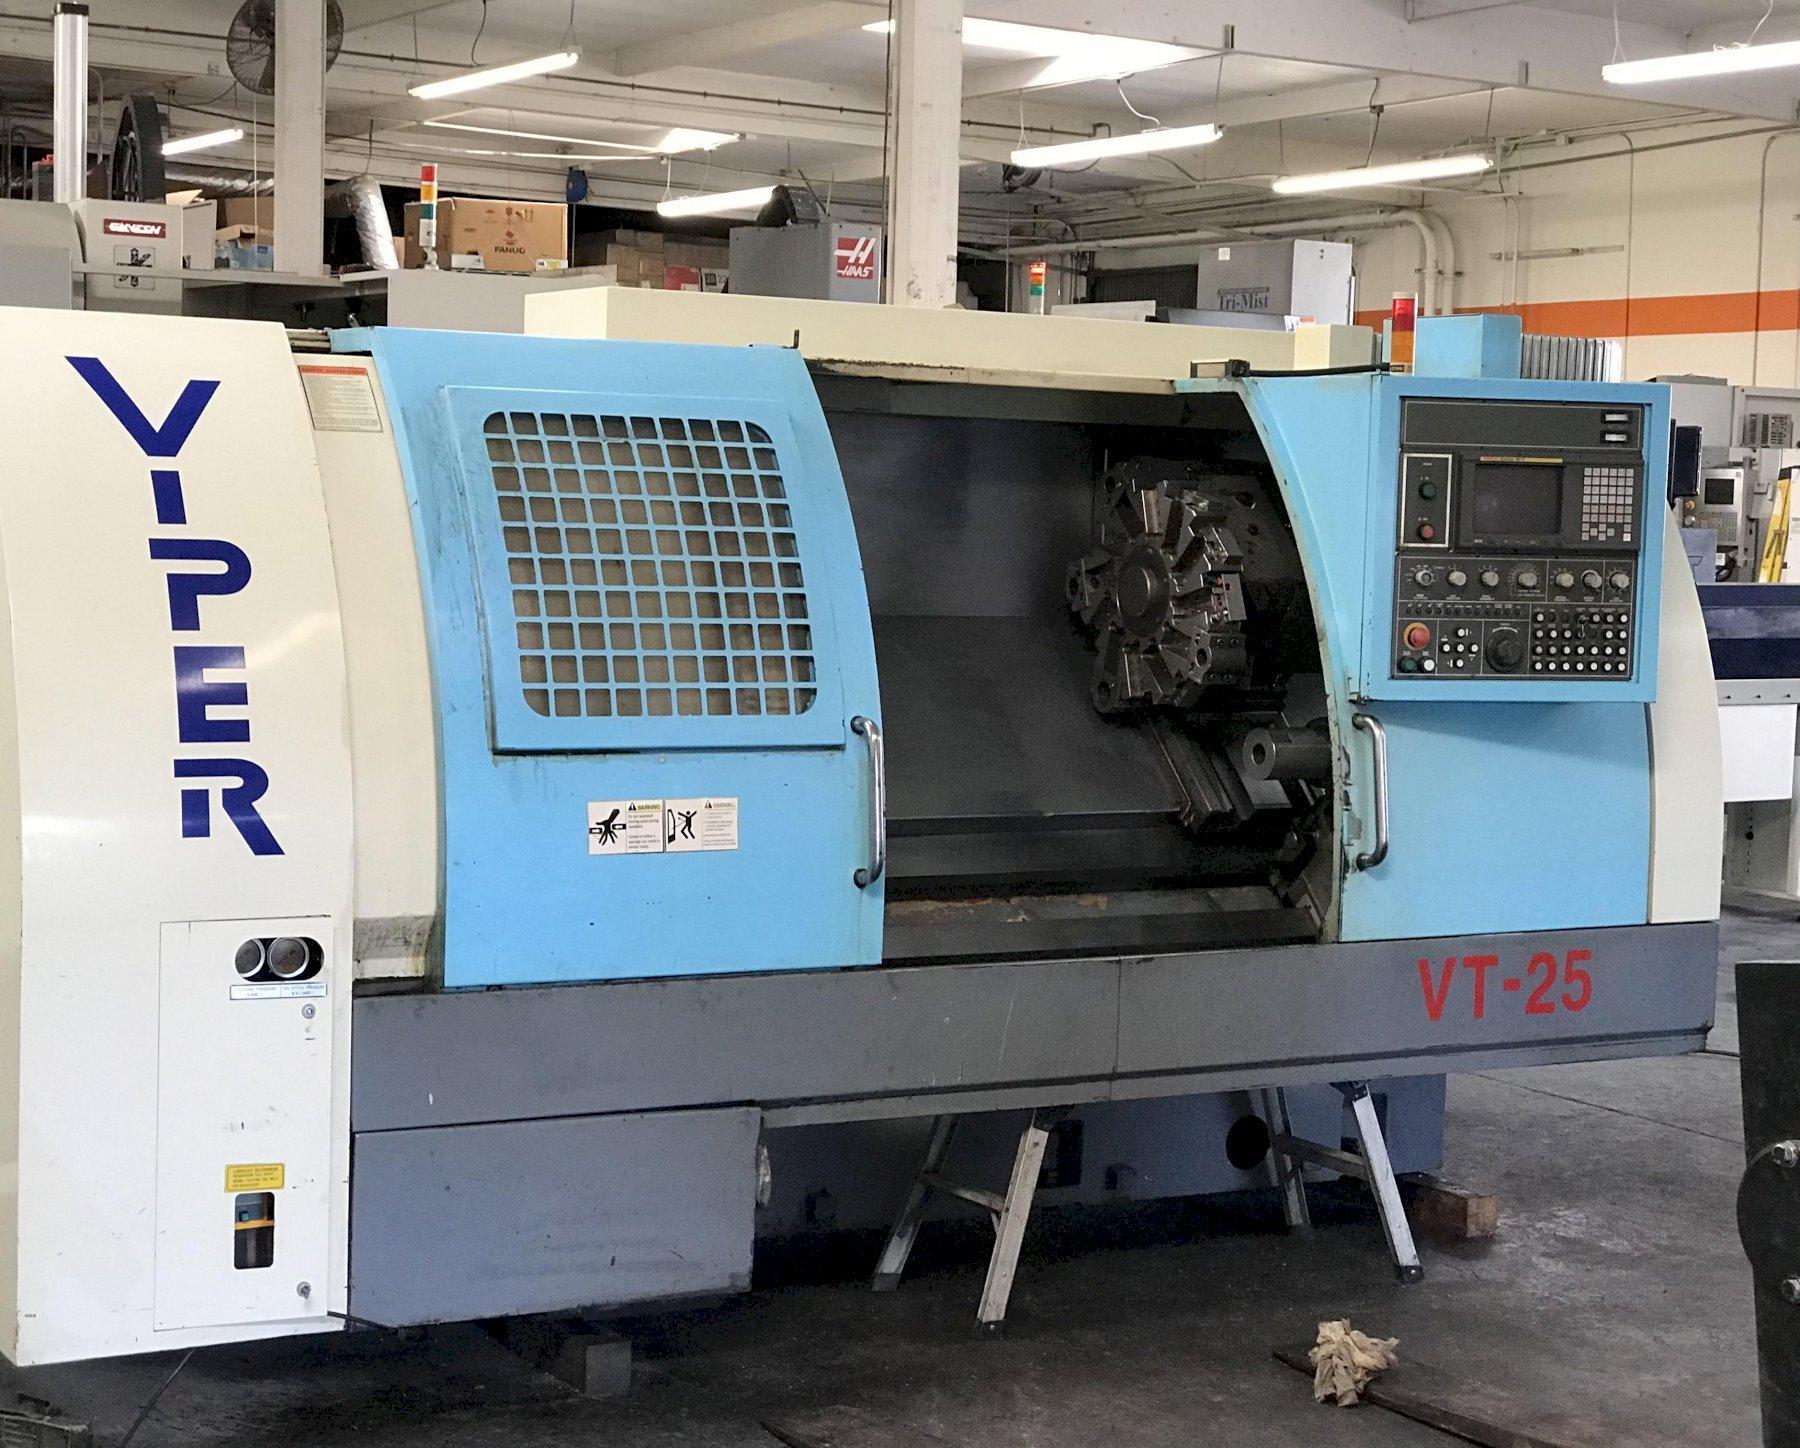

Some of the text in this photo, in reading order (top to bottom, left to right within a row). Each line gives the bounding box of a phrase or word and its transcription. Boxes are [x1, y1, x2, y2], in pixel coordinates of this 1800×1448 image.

[837, 265, 874, 278] HAAS
[1218, 293, 1269, 310] Tri-Mist
[64, 356, 286, 856] VIPER
[1416, 948, 1594, 1023] VT-25
